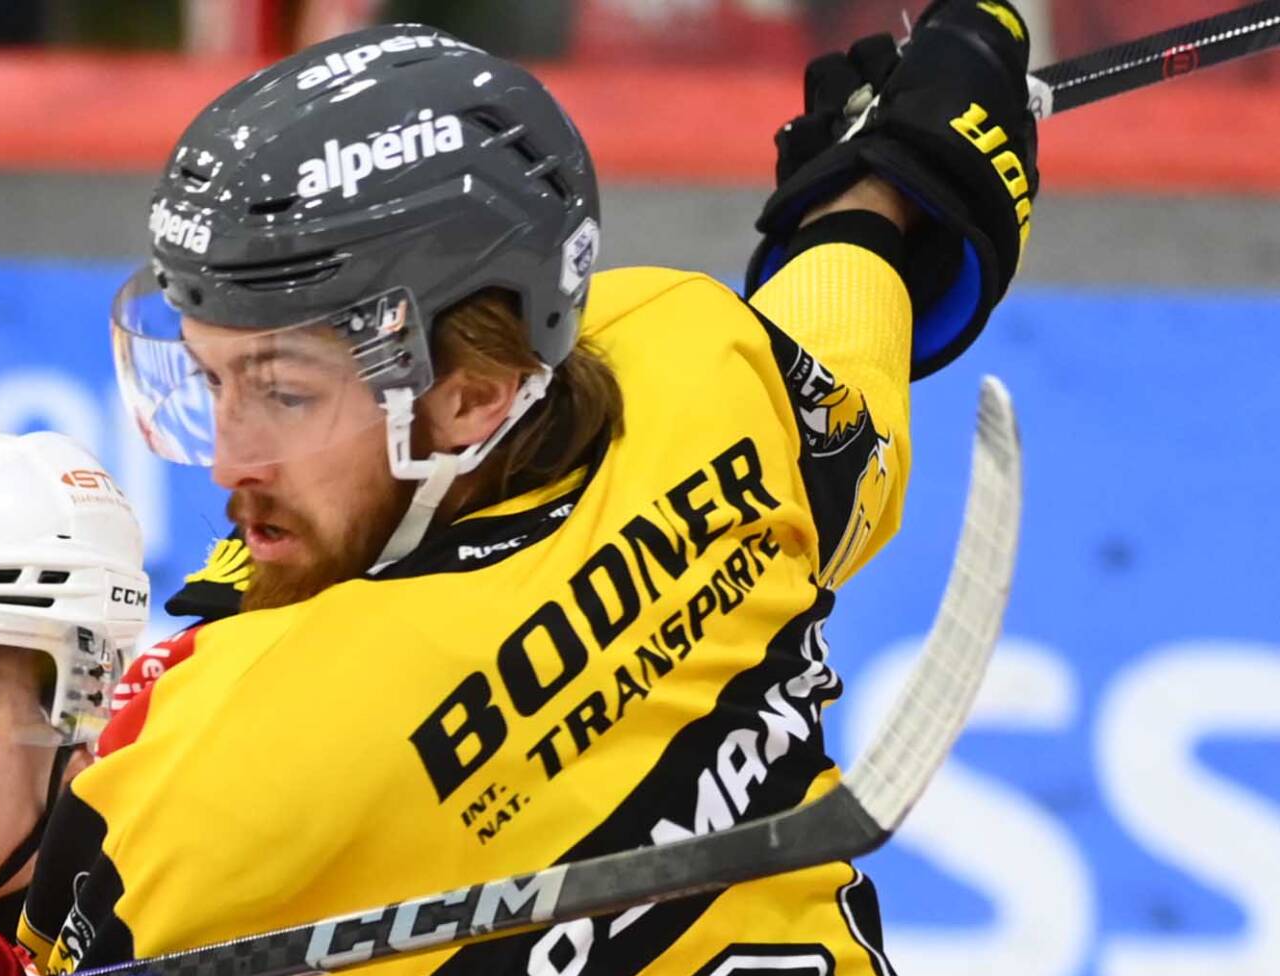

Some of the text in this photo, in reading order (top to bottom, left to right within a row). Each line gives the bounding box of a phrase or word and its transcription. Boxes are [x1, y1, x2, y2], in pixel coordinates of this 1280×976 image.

[297, 108, 463, 198] alperia
[111, 586, 147, 608] CCM
[408, 437, 781, 804] BODNER
[460, 782, 508, 828] INT.
[478, 794, 531, 845] NAT.
[304, 862, 571, 970] CCM
